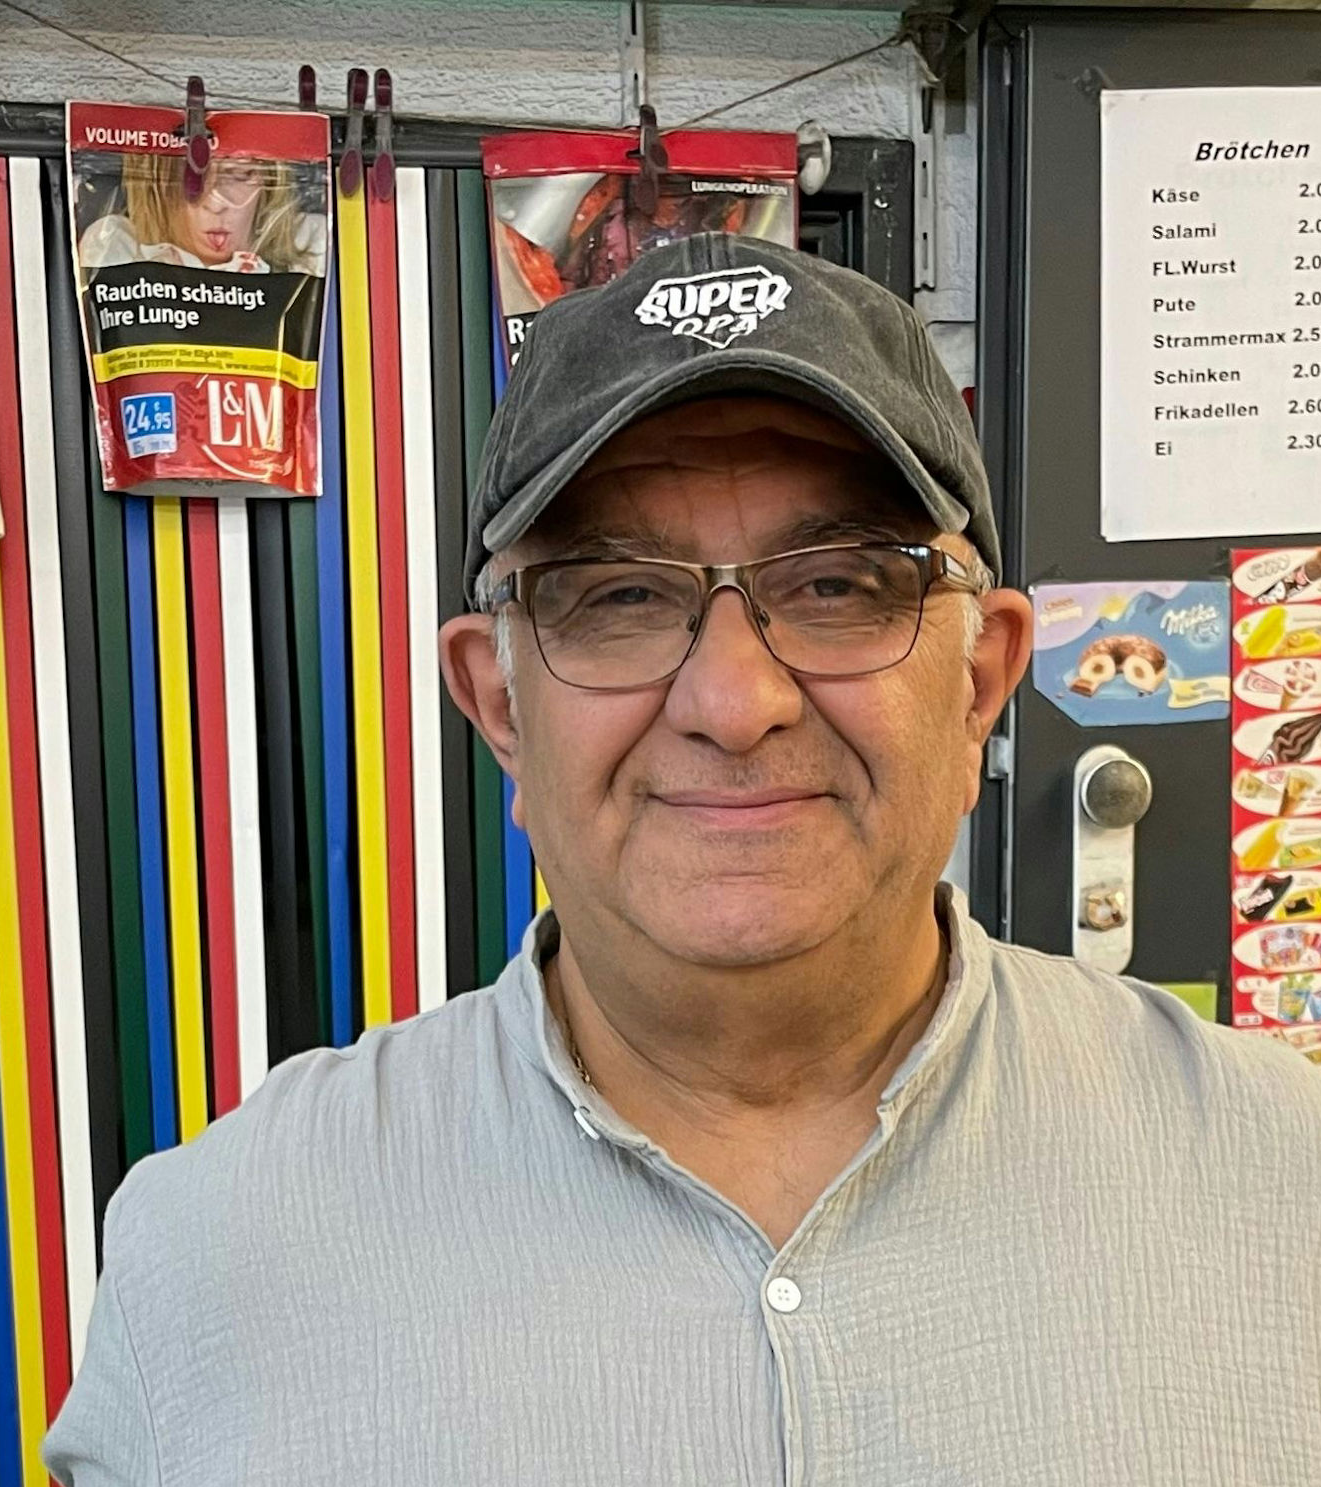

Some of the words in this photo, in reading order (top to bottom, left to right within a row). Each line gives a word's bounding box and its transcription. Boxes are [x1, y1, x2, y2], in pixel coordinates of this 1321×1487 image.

[86, 127, 147, 145] VOLUME
[1195, 141, 1310, 161] Brötchen
[1152, 189, 1200, 203] Käse
[1152, 223, 1216, 240] Salami
[1153, 260, 1236, 276] FL.Wurst
[96, 279, 177, 303] Rauchen
[182, 282, 265, 309] schädigt
[635, 276, 791, 326] SUPER
[1154, 299, 1195, 312] Pute
[100, 306, 134, 330] Ihre
[139, 306, 199, 328] Lunge
[672, 314, 758, 336] OPA
[1154, 331, 1286, 348] Strammermax
[1154, 369, 1240, 384] Schinken
[208, 377, 284, 452] L&M
[1155, 404, 1259, 420] Frikadellen
[1155, 441, 1172, 455] Ei
